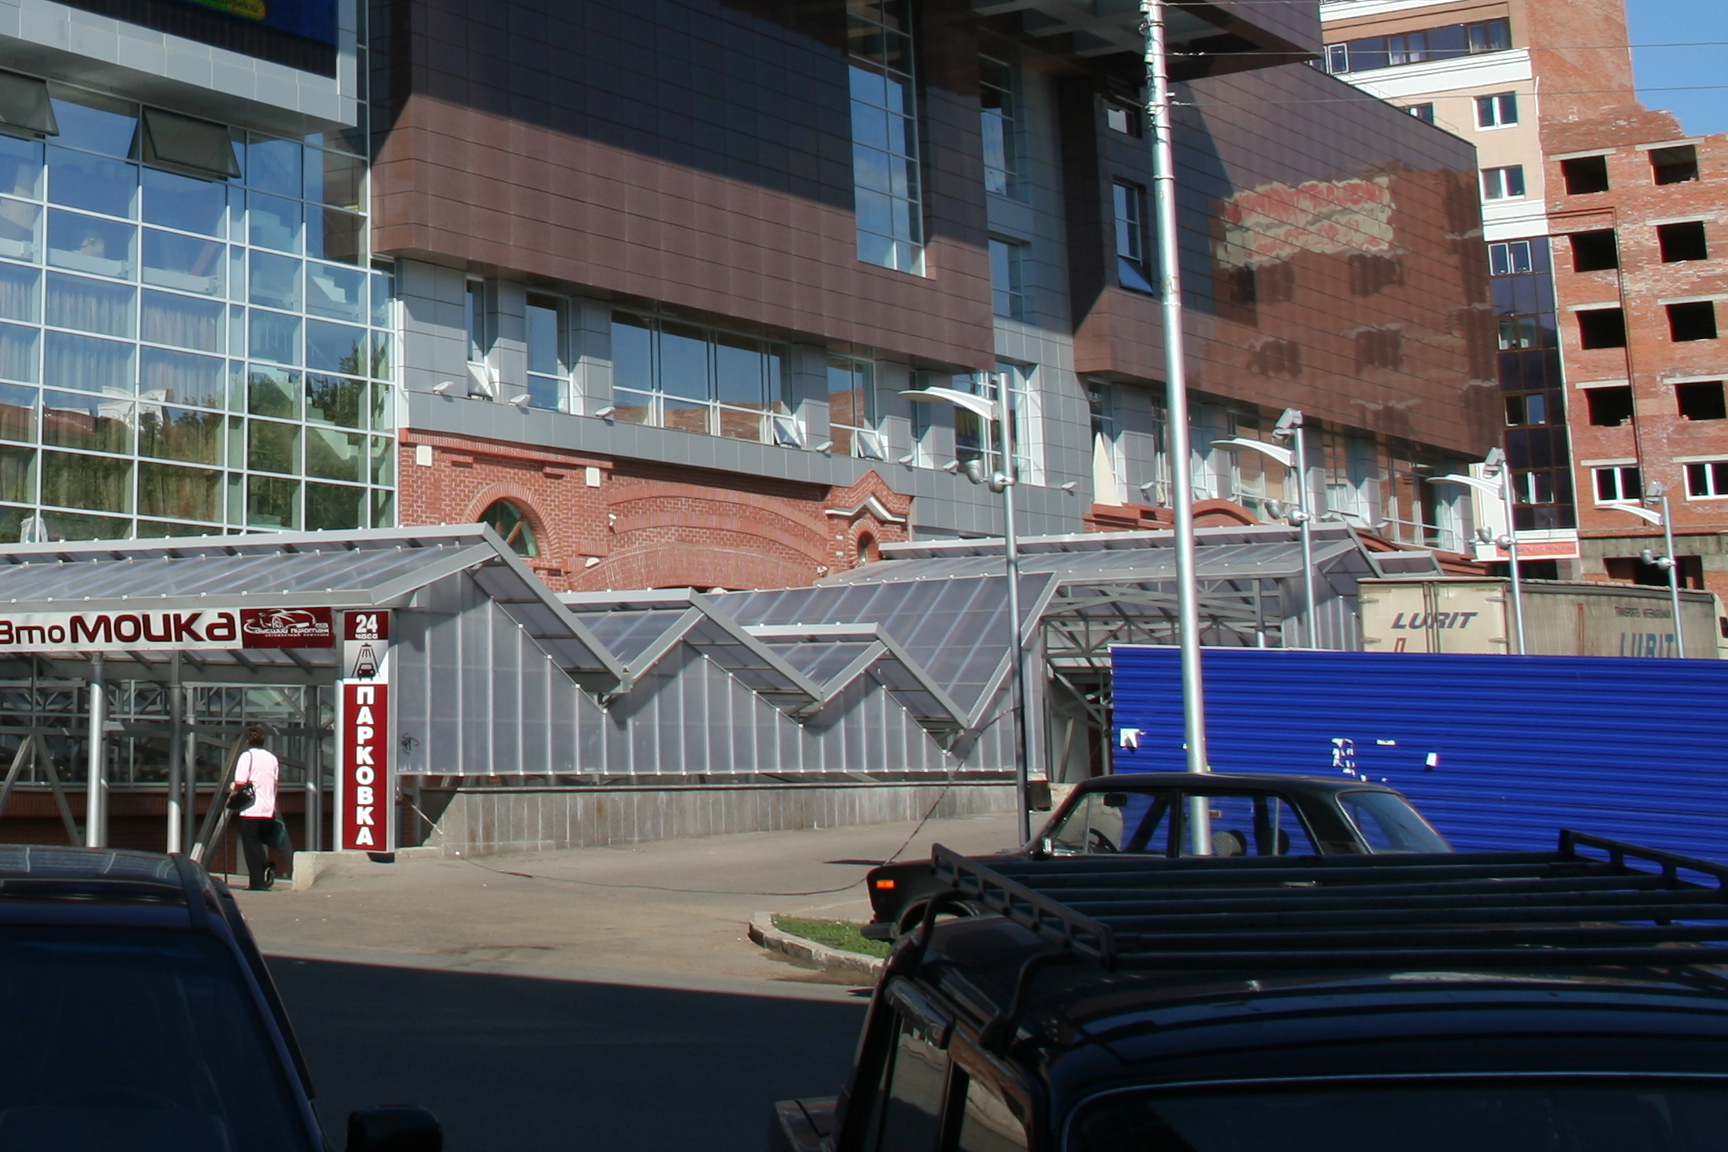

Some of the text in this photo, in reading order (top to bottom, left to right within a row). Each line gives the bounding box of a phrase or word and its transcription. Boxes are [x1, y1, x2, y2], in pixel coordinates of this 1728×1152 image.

[356, 614, 378, 634] 24
[1391, 612, 1478, 629] LURIT
[355, 685, 375, 846] ПАРКОВКА
